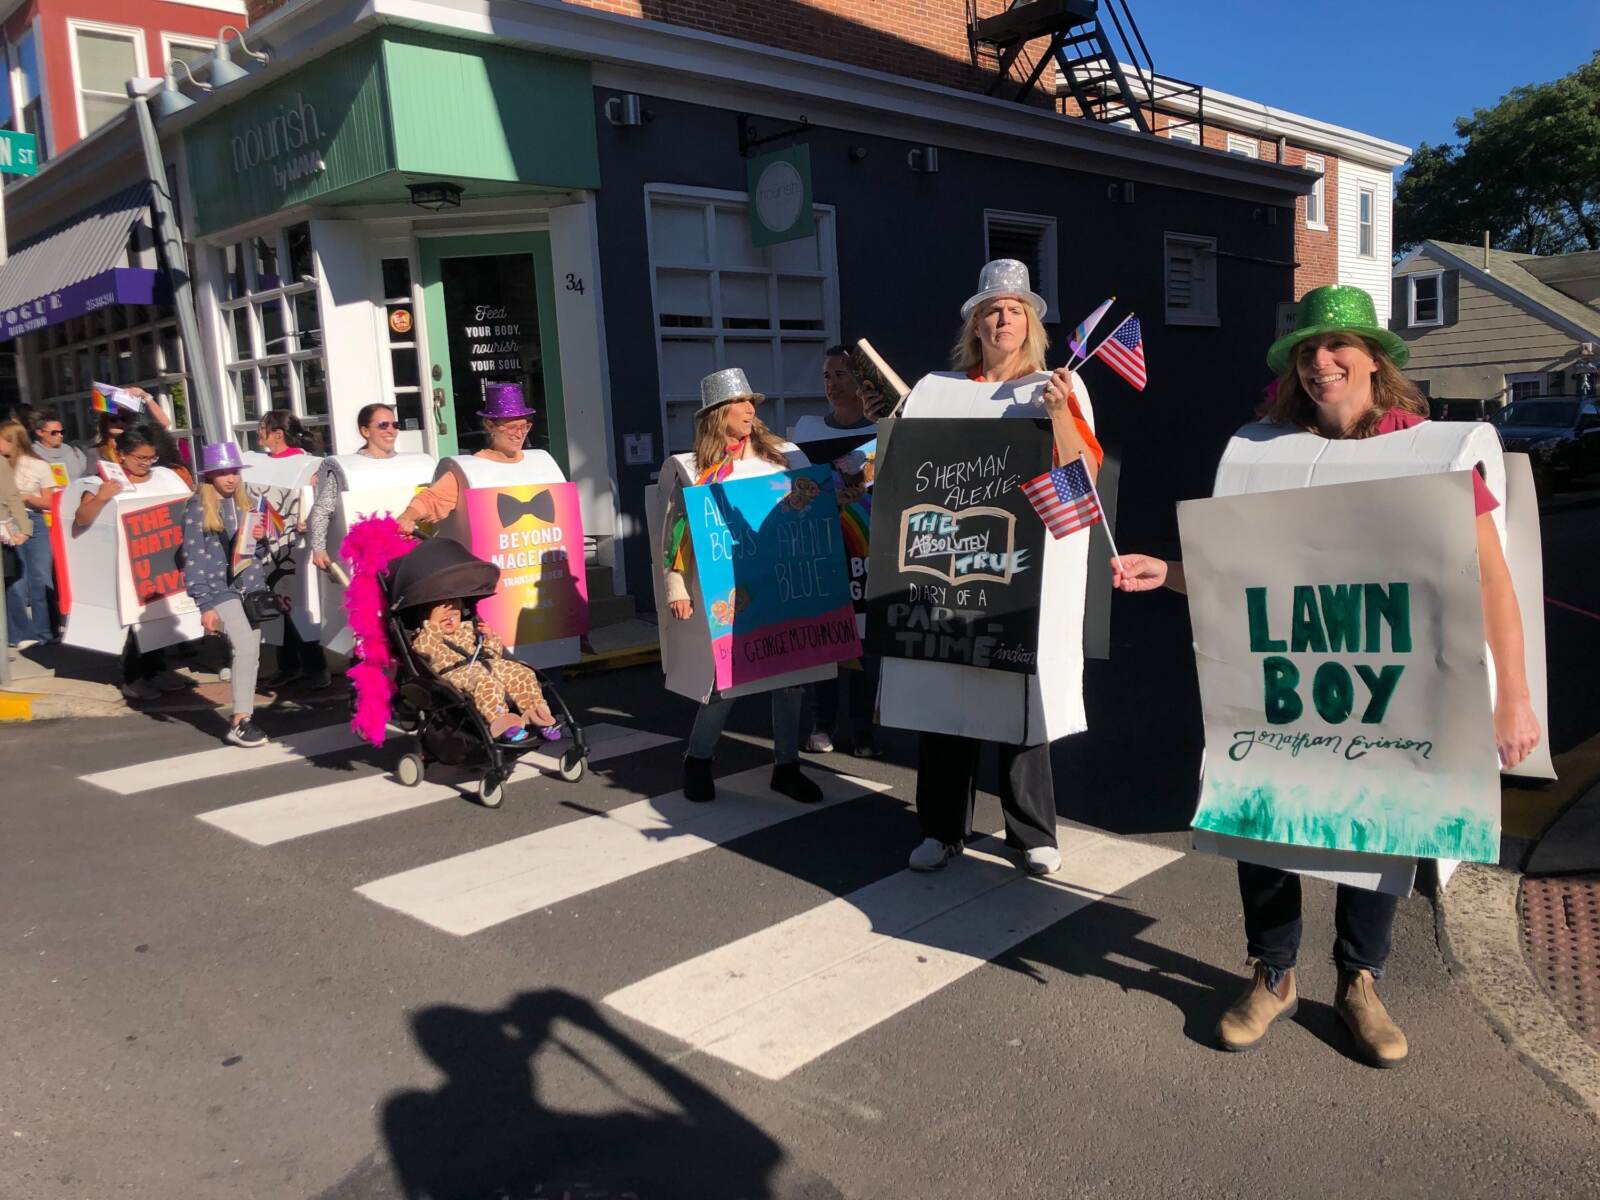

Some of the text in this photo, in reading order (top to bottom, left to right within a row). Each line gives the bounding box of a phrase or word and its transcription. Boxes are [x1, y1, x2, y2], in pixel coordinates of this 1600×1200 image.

[18, 148, 33, 164] ST
[565, 273, 585, 295] 34
[475, 304, 508, 321] Feed
[464, 326, 492, 338] YOUR
[471, 340, 519, 354] nourish
[470, 358, 522, 371] YOUR SOUL
[915, 445, 1010, 492] SHERMAN
[126, 505, 173, 536] THE
[704, 492, 734, 528] ALL
[908, 511, 960, 537] THE
[130, 525, 184, 558] HATE
[499, 526, 563, 550] BEYOND
[709, 526, 758, 562] BOYS
[906, 528, 990, 558] ABSOLUTELY
[135, 559, 151, 579] U
[491, 544, 568, 570] MAGENTA
[955, 548, 1032, 574] TRUE
[774, 556, 832, 602] BLUE
[909, 582, 987, 606] DIARY OF A
[1245, 582, 1413, 653] LAWN
[896, 631, 997, 667] TIME
[1263, 656, 1406, 725] BOY
[1228, 730, 1343, 762] Jonathan
